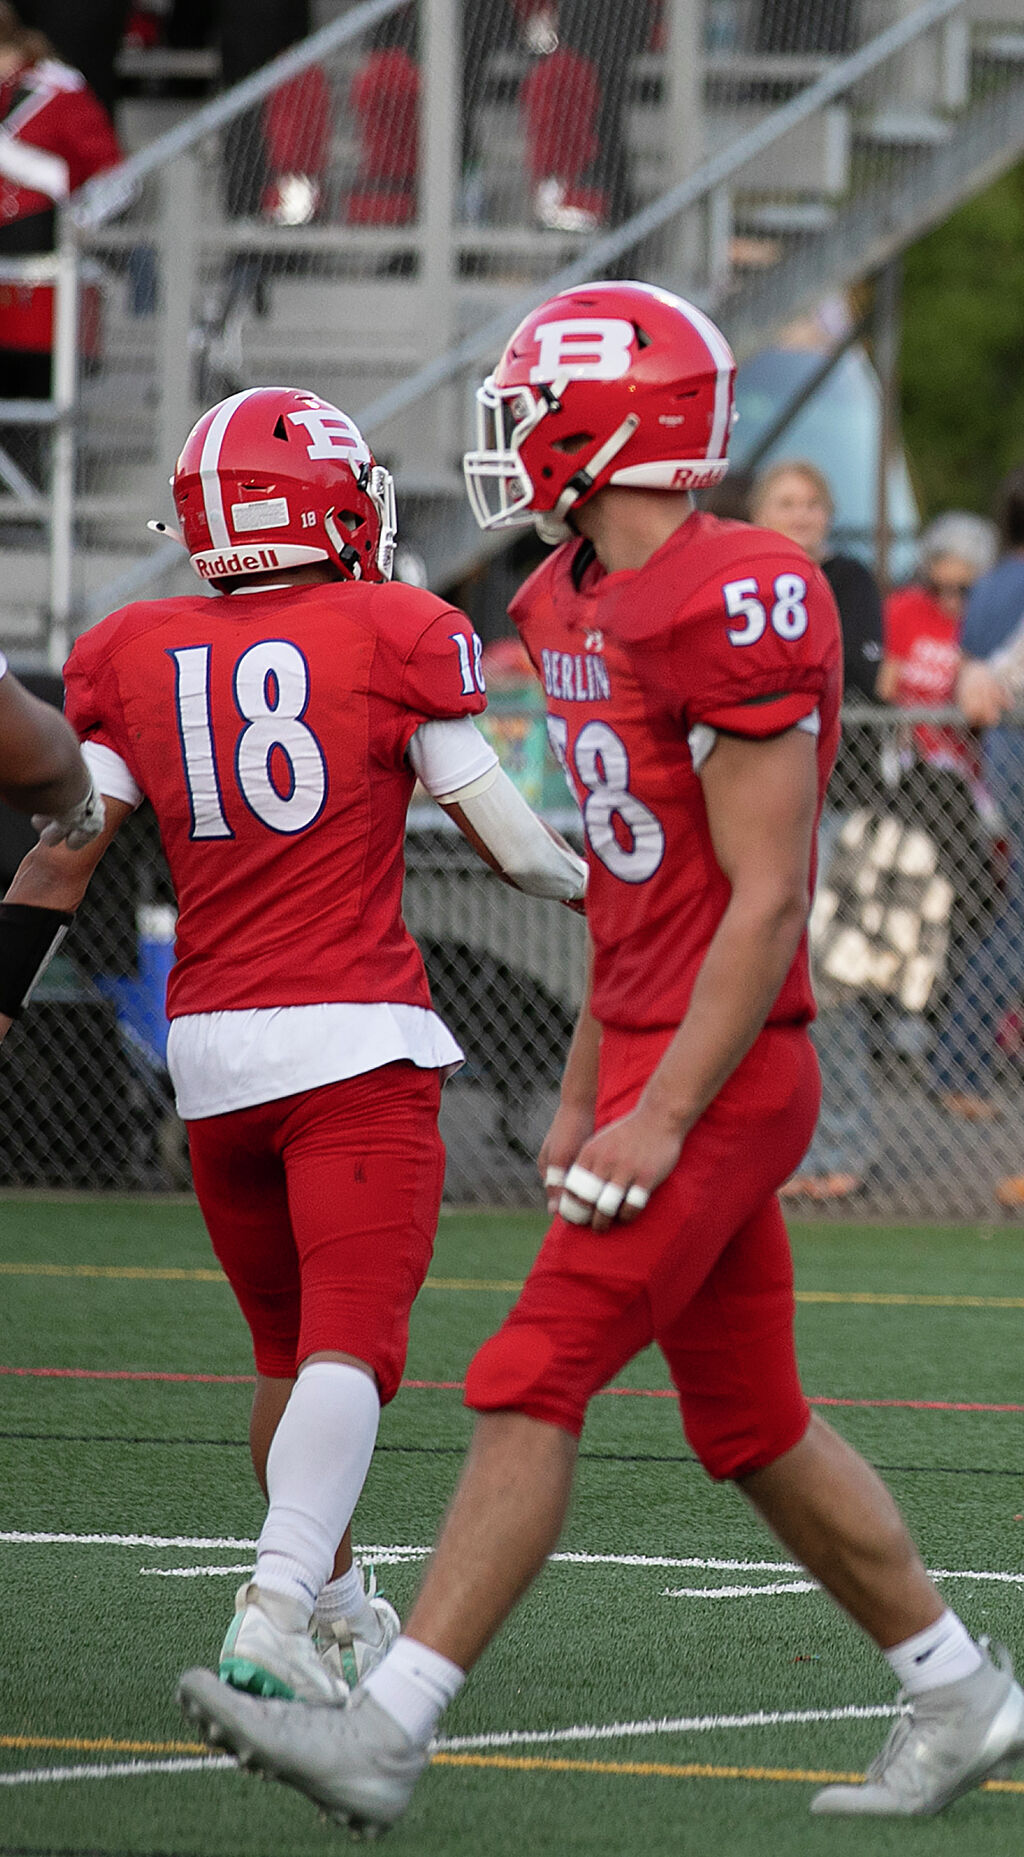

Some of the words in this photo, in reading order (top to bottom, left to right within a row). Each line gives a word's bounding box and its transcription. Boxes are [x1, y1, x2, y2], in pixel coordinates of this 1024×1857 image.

[529, 318, 635, 384] B
[287, 409, 372, 463] B
[300, 511, 317, 528] 18
[196, 549, 279, 577] Riddell
[722, 572, 808, 647] 58
[541, 648, 611, 701] BERLIN
[164, 638, 329, 842] 18
